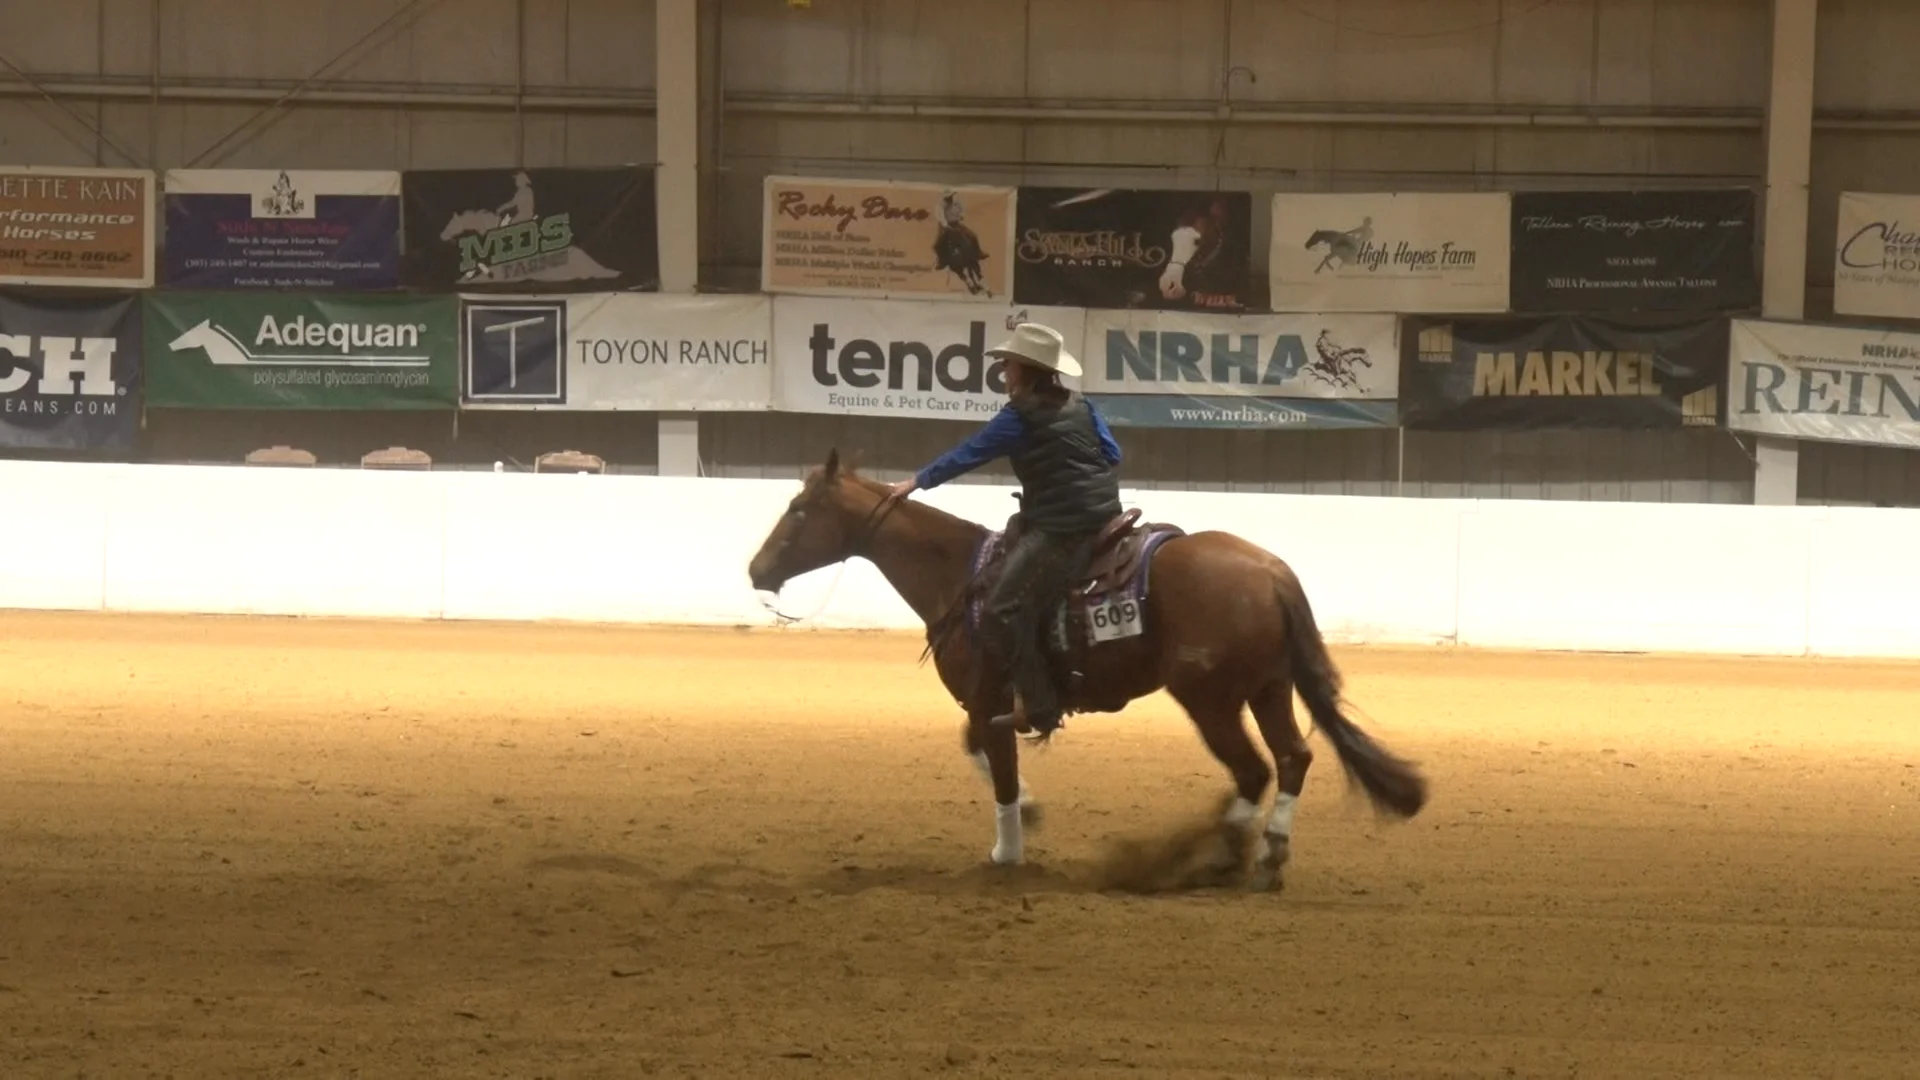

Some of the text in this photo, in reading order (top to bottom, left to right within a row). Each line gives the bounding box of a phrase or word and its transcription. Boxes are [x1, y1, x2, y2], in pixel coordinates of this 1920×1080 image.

[0, 176, 137, 201] ETTE KAIN
[4, 225, 96, 240] Horses
[1053, 257, 1123, 267] RANCH
[1356, 241, 1476, 272] High Hopes Farm
[1882, 258, 1920, 272] HO
[576, 338, 768, 366] TOYON RANCH
[1105, 328, 1310, 386] NRHA
[1861, 343, 1908, 360] NRHA
[1472, 351, 1662, 397] MARKEL
[828, 393, 879, 409] Equine
[884, 394, 894, 408] &
[899, 395, 922, 410] Pet
[926, 396, 961, 412] Care
[1170, 405, 1307, 423] www.nrha.com
[1093, 602, 1136, 628] 609
